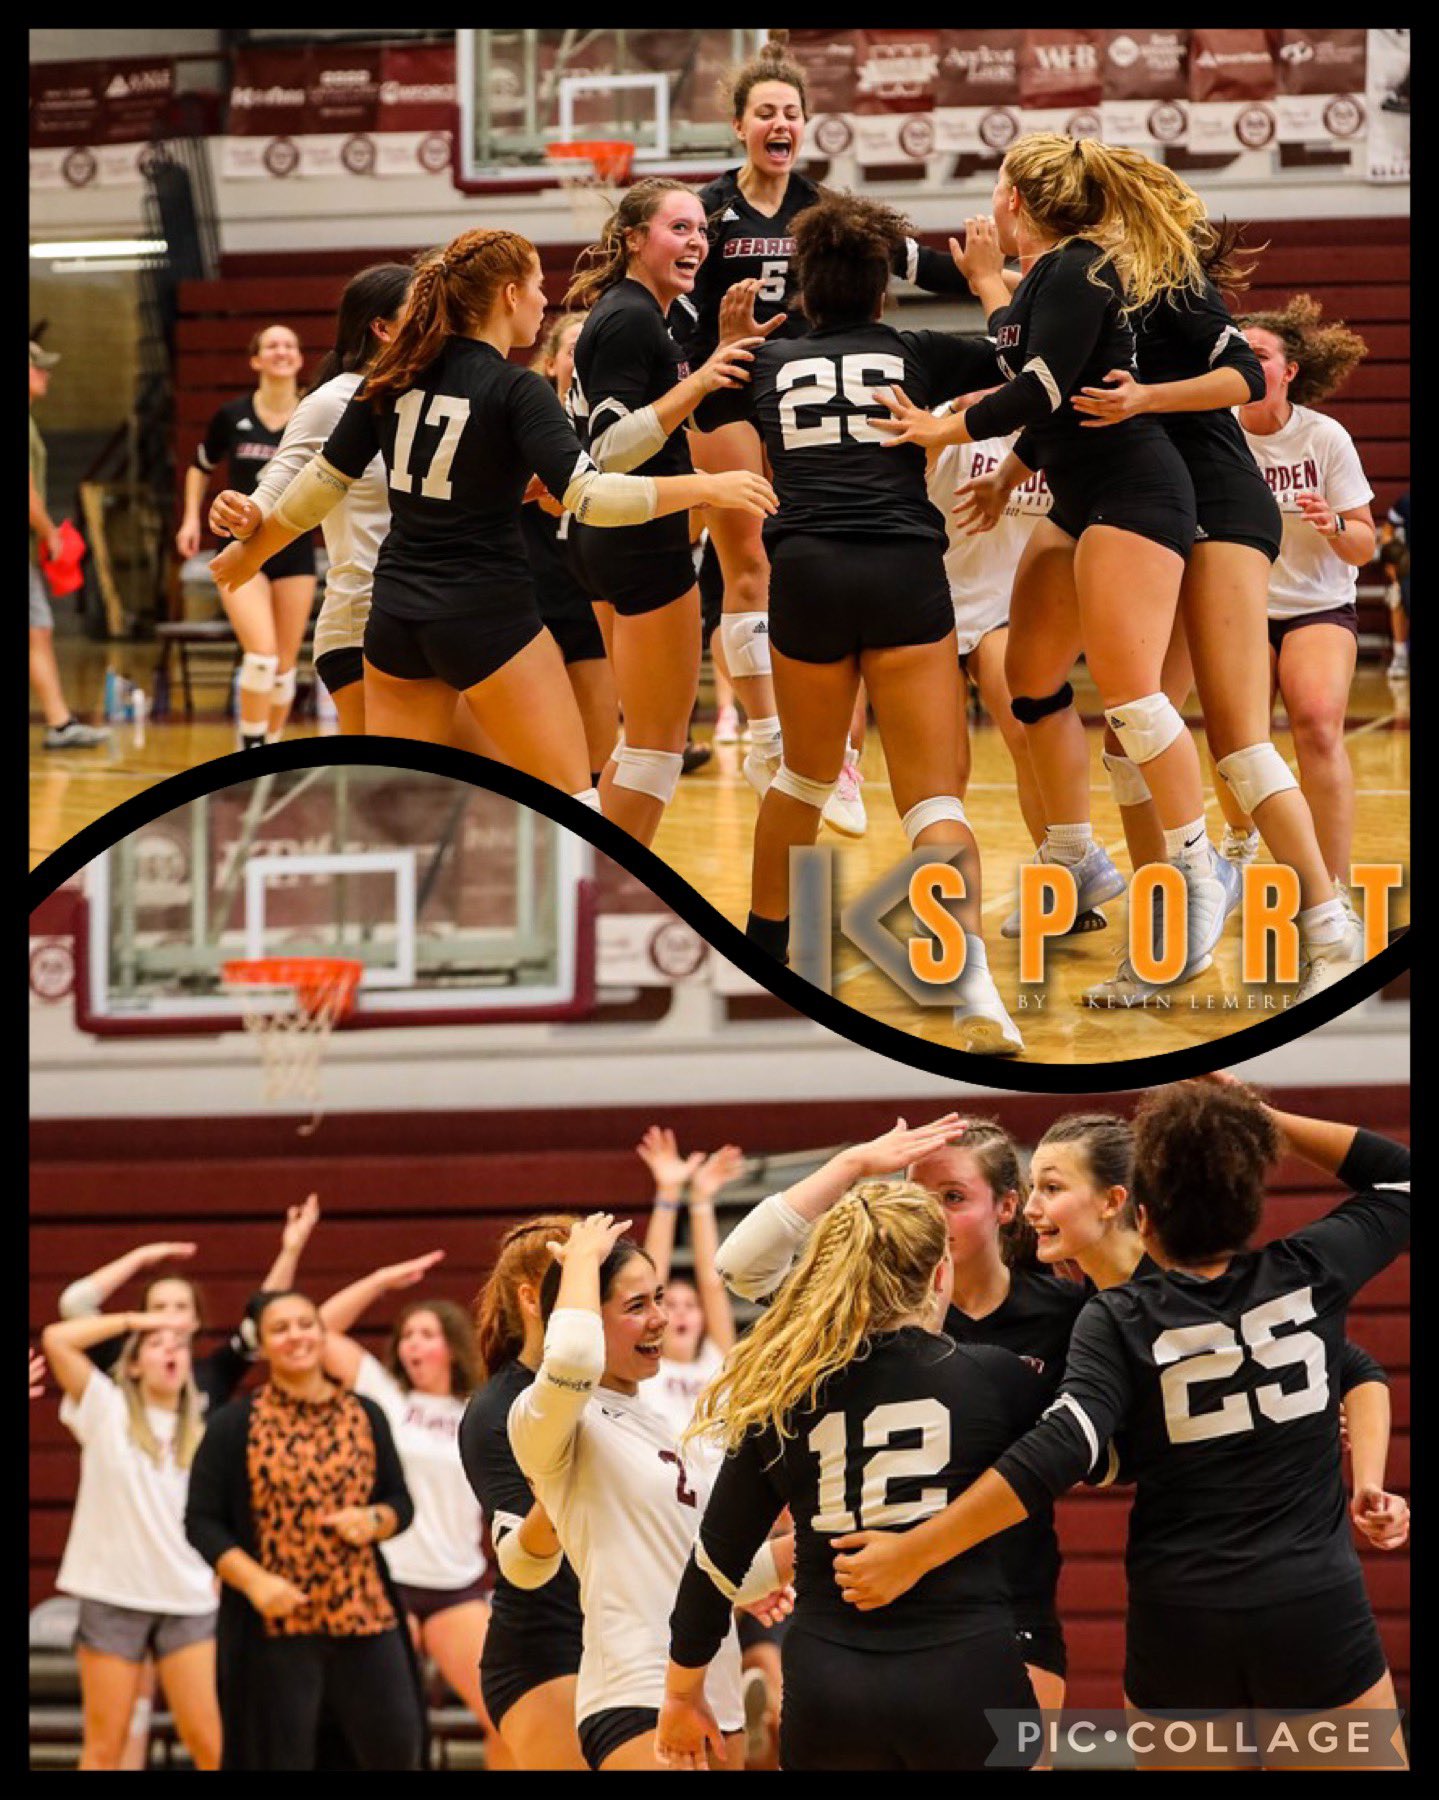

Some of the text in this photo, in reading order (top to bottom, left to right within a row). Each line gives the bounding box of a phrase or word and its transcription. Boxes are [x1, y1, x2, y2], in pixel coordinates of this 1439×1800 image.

[759, 261, 788, 301] 5
[389, 389, 471, 500] 17
[776, 353, 905, 450] 25
[1152, 1286, 1330, 1444] 25
[659, 1449, 696, 1508] 2
[808, 1398, 951, 1533] 12
